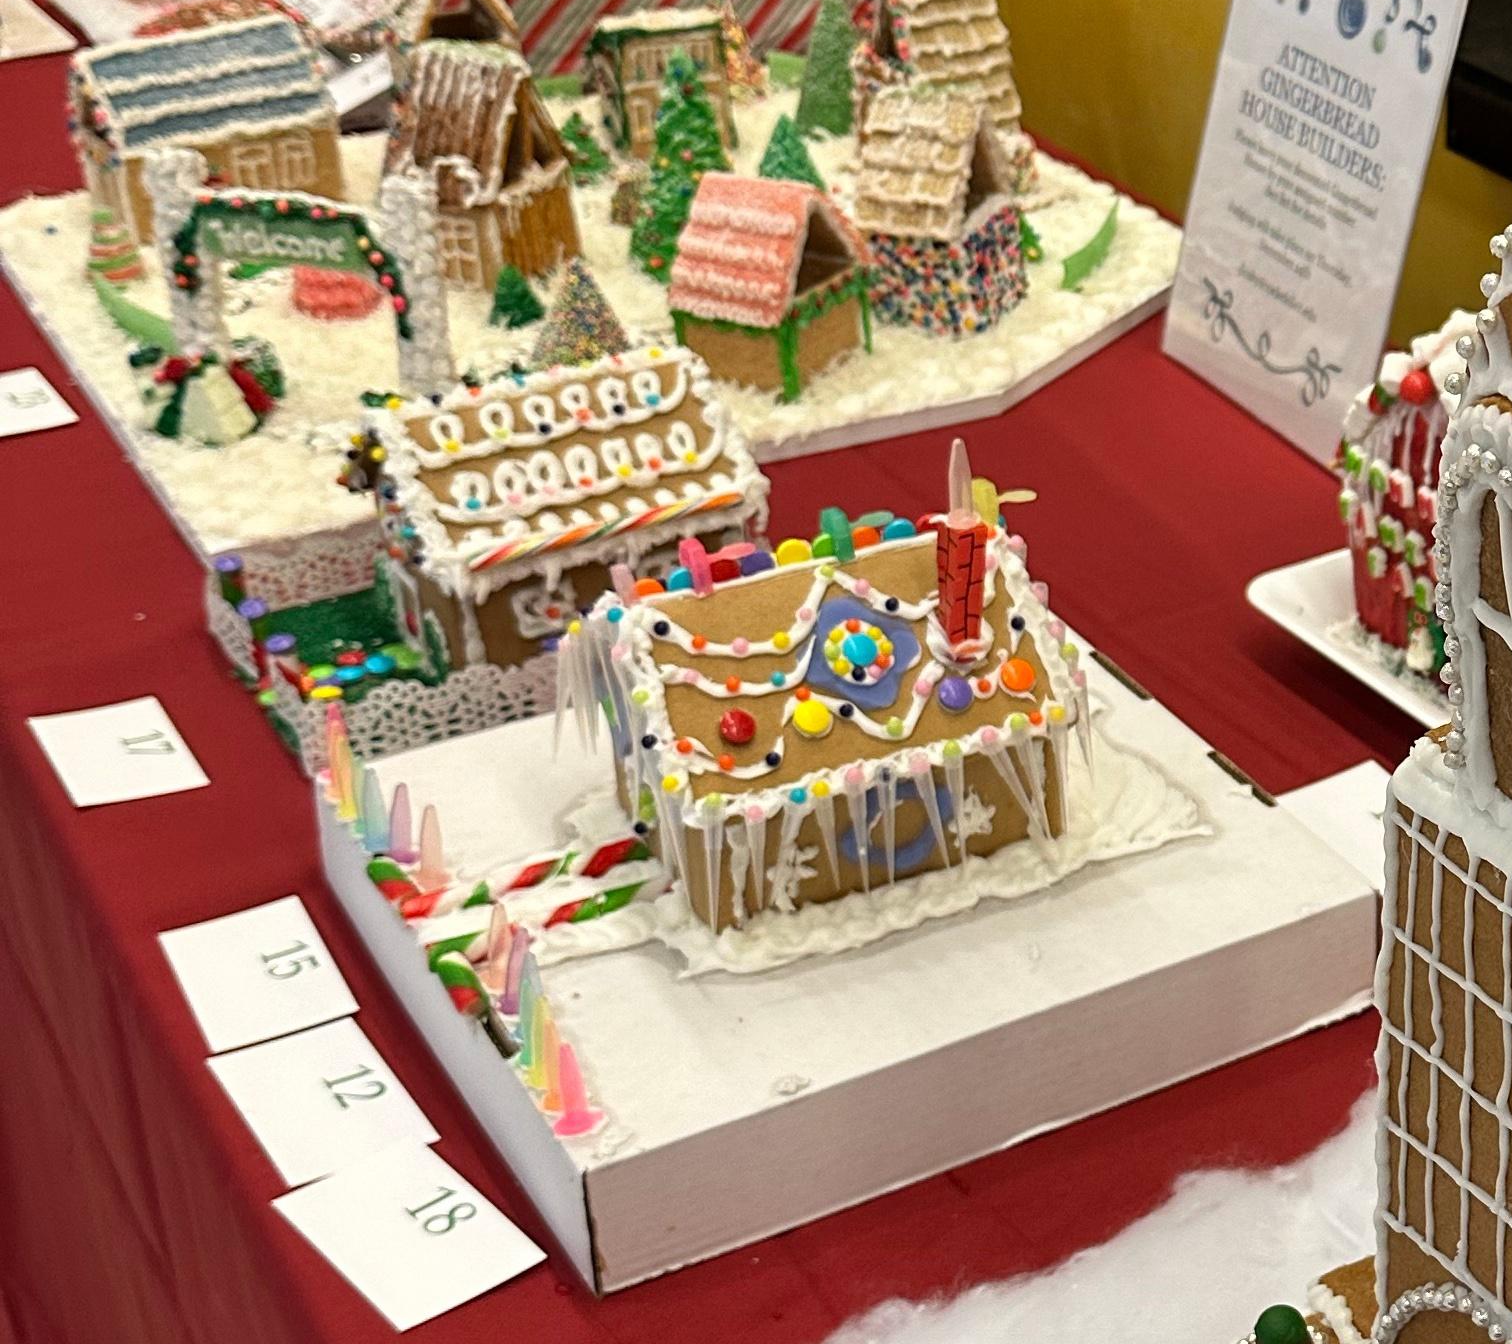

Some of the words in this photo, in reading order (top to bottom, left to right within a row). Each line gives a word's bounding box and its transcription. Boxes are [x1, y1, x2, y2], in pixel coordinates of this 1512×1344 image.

[1277, 42, 1377, 111] ATTENTION
[1260, 67, 1381, 150] GINGERBREAD
[1238, 89, 1299, 141] HOUSE
[1299, 121, 1388, 193] BUILDERS:
[118, 728, 177, 755] 17
[260, 940, 322, 980] 15
[321, 1064, 388, 1110] 12
[404, 1186, 478, 1236] 18
